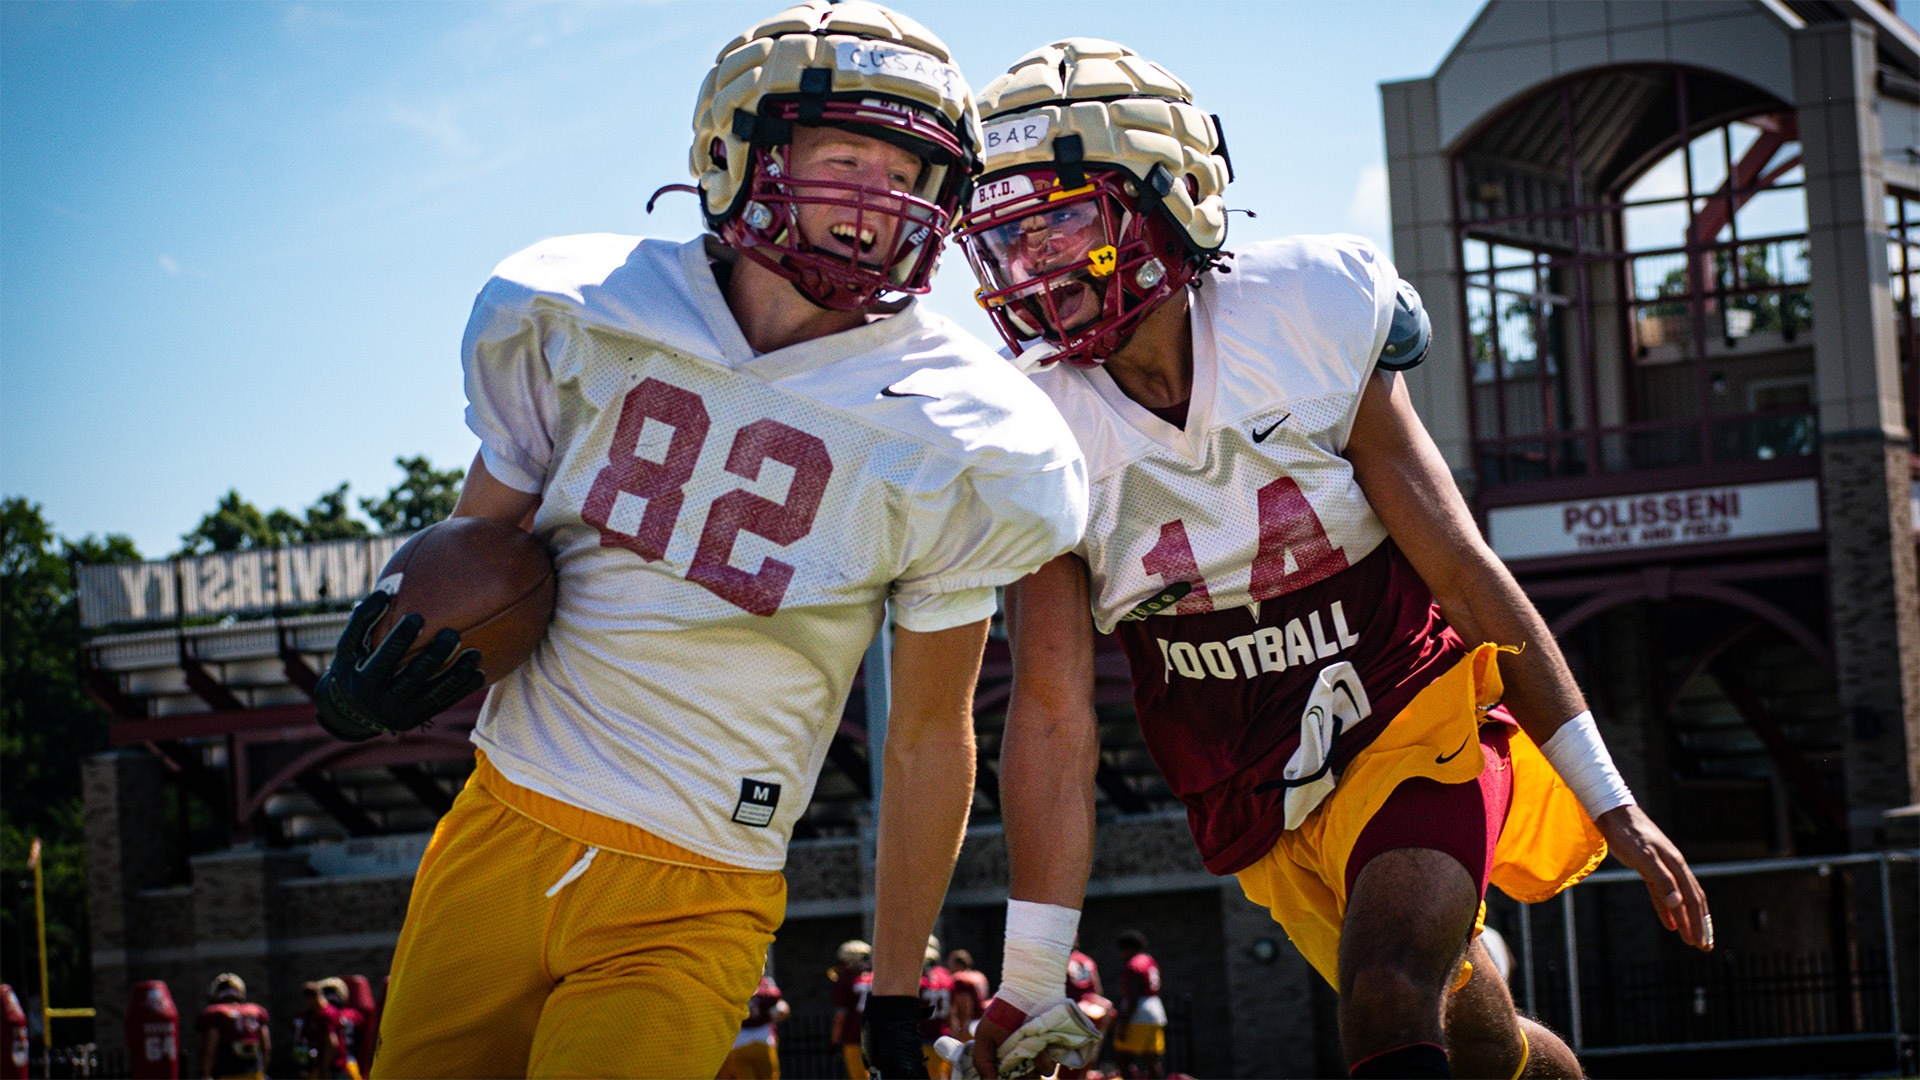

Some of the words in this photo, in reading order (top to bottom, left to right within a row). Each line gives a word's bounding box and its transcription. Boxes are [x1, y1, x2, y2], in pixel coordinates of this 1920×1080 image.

[978, 181, 1015, 203] B.T.D.
[581, 376, 834, 617] 82
[1563, 492, 1739, 533] POLISSENI
[1141, 475, 1350, 615] 14
[1576, 530, 1631, 546] TRACK
[1640, 526, 1674, 541] AND
[1683, 520, 1729, 536] FIELD
[753, 785, 770, 802] M
